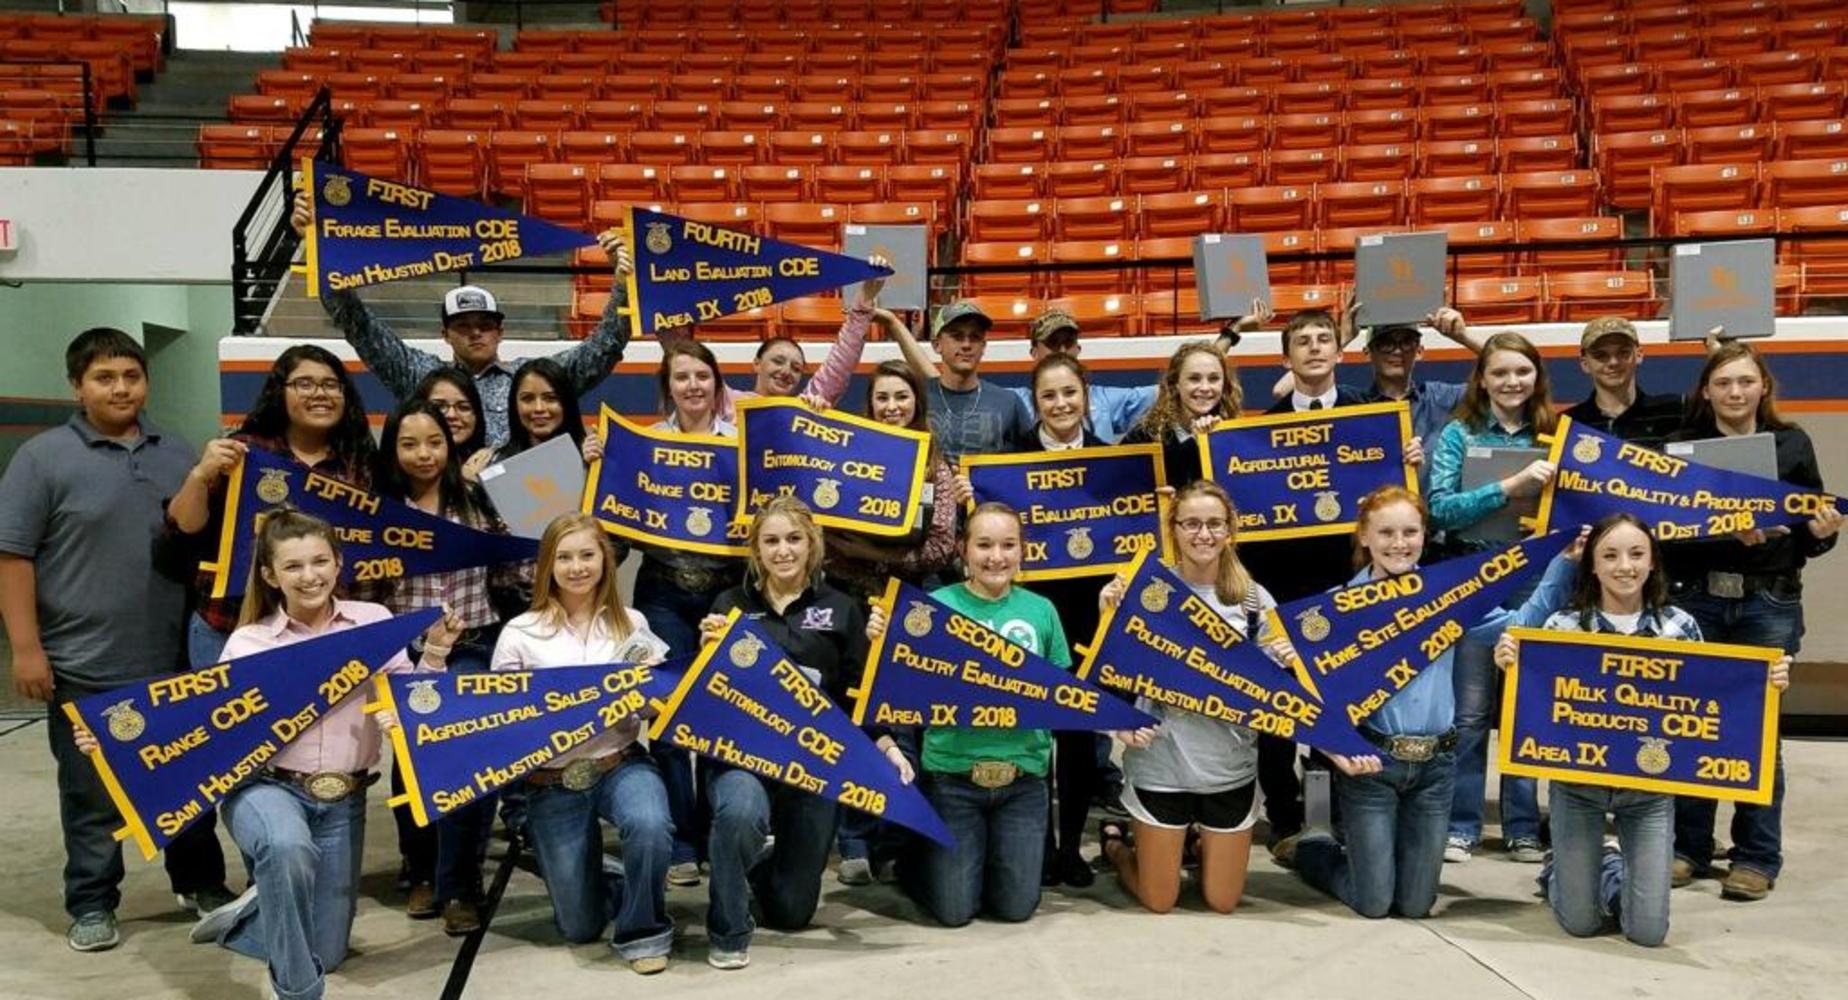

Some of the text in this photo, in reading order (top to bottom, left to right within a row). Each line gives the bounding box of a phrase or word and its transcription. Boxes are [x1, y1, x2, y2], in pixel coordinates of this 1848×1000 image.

[367, 178, 435, 210] FIRST
[475, 220, 519, 239] CDE
[683, 221, 761, 255] FOURTH
[480, 240, 522, 263] 2018
[779, 257, 819, 276] CDE
[696, 298, 722, 320] IX
[734, 288, 773, 312] 2018
[791, 415, 855, 448] FIRST
[1271, 424, 1333, 448] FIRST
[653, 447, 716, 470] FIRST
[841, 460, 886, 482] CDE
[1617, 444, 1688, 478] FIRST
[304, 472, 380, 515] FIFTH
[690, 482, 732, 503] CDE
[1025, 467, 1087, 491] FIRST
[1286, 470, 1330, 491] CDE
[859, 496, 902, 519] 2018
[1112, 494, 1156, 516] CDE
[1272, 504, 1298, 524] IX
[1783, 494, 1837, 516] CDE
[645, 508, 668, 531] IX
[726, 521, 750, 539] 20
[1708, 512, 1755, 536] 2018
[383, 527, 435, 550] CDE
[1024, 532, 1157, 561] IX 2018
[354, 558, 403, 581] 2018
[1479, 545, 1529, 584] CDE
[1333, 572, 1423, 614] SECOND
[1179, 594, 1243, 649] FIRST
[945, 614, 1026, 668] SECOND
[1385, 658, 1418, 690] IX
[1420, 619, 1464, 661] 2018
[602, 664, 653, 693] CDE
[1601, 652, 1685, 682] FIRST
[147, 664, 233, 707] FIRST
[319, 659, 370, 705] 2018
[457, 672, 533, 695] FIRST
[770, 658, 832, 717] FIRST
[210, 688, 269, 730] CDE
[598, 690, 646, 728] 2018
[1054, 685, 1100, 713] CDE
[1272, 690, 1322, 727] CDE
[1705, 700, 1720, 715] &
[929, 704, 958, 726] IX
[972, 705, 1017, 727] 2018
[1248, 708, 1296, 737] 2018
[1662, 713, 1720, 741] CDE
[798, 726, 845, 765] CDE
[1576, 742, 1609, 767] IX
[1696, 756, 1752, 782] 2018
[838, 781, 887, 815] 2018
